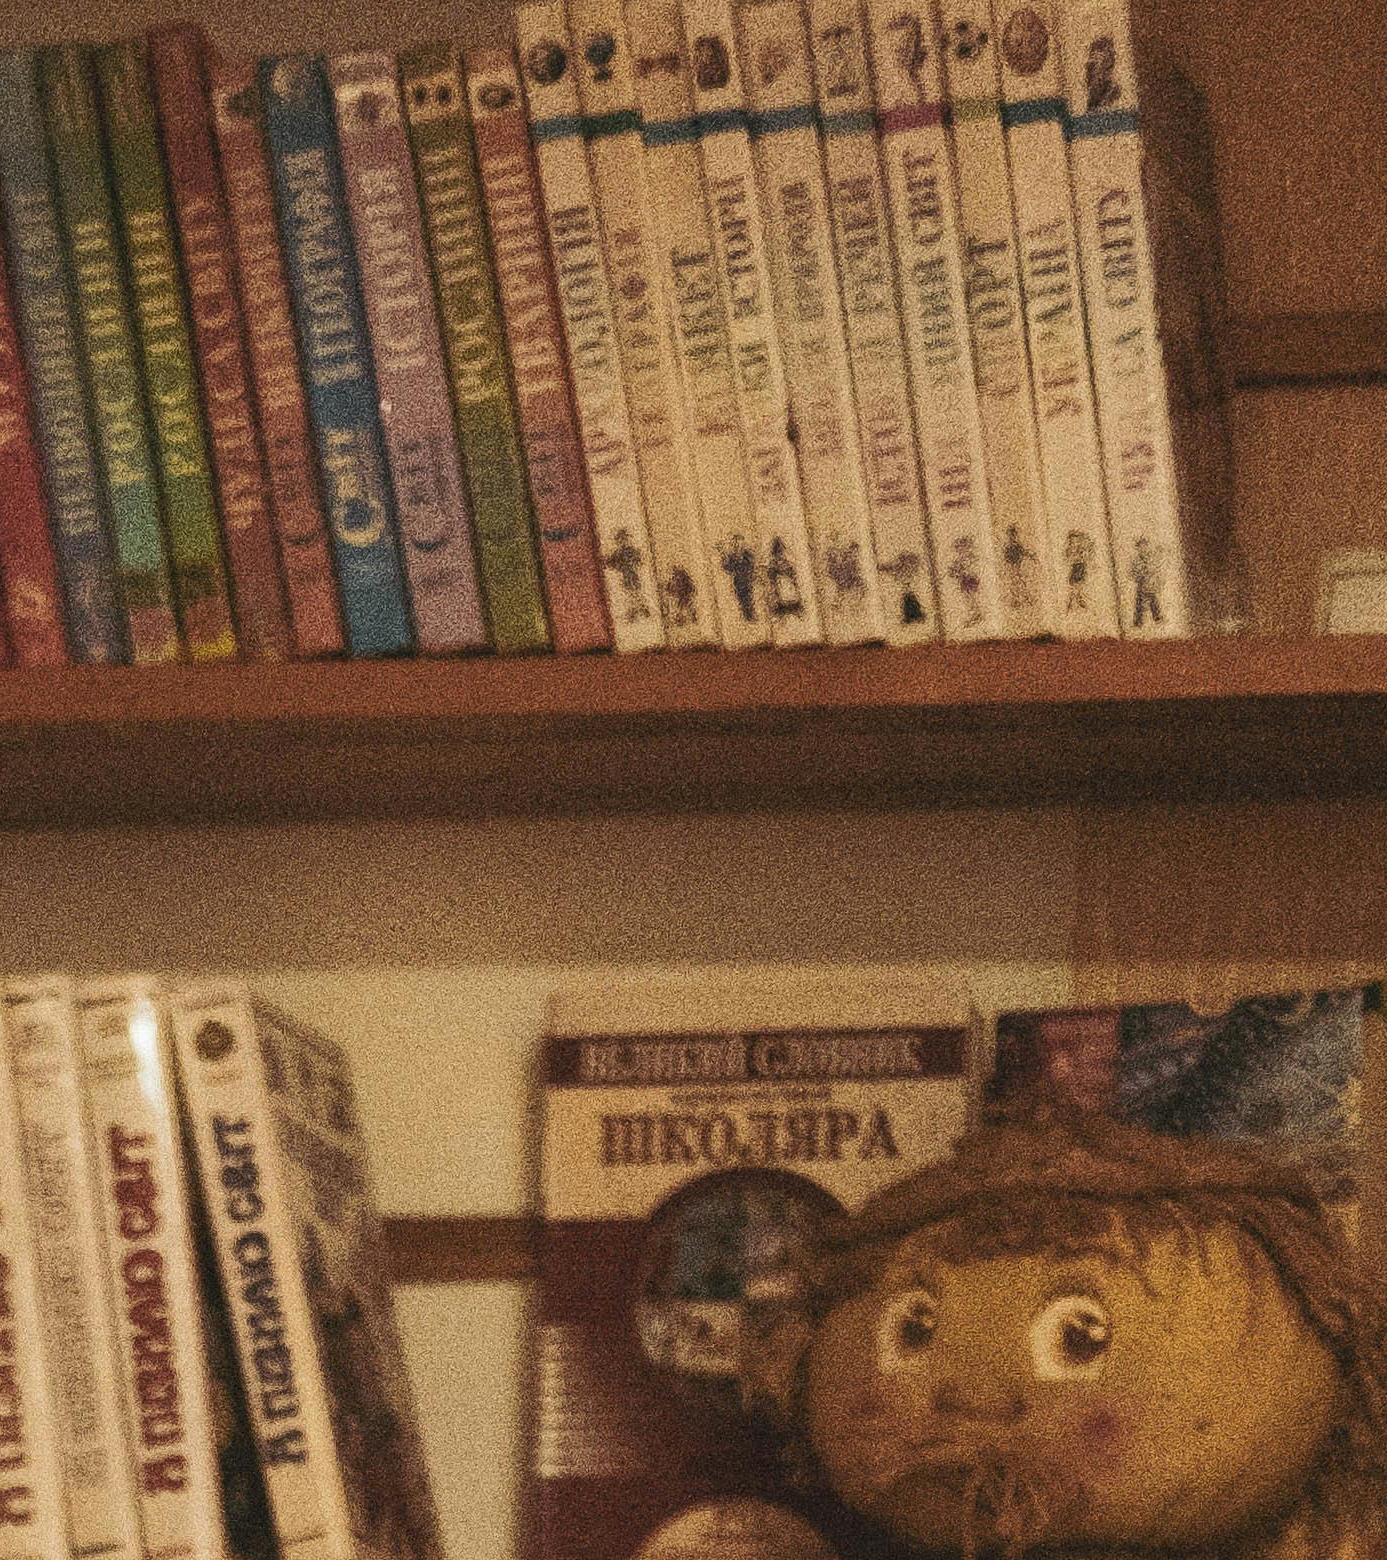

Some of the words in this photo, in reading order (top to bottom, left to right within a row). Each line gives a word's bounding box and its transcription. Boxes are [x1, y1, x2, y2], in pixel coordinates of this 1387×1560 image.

[896, 143, 949, 247] СВІТ
[1088, 181, 1145, 312] СВІТУ
[177, 187, 234, 332] СВІТУ
[355, 161, 431, 375] ІСТОРІЯ
[71, 214, 148, 490] РОСЛИНИ
[126, 205, 202, 483] РОСЛИНИ
[200, 340, 267, 532] ЧУДЕСА
[100, 1117, 165, 1243] СВІТ
[210, 1108, 265, 1224] СВІТ
[598, 1105, 899, 1166] ШКОЛЯРА
[140, 1451, 192, 1498] Я
[258, 1428, 308, 1471] Я
